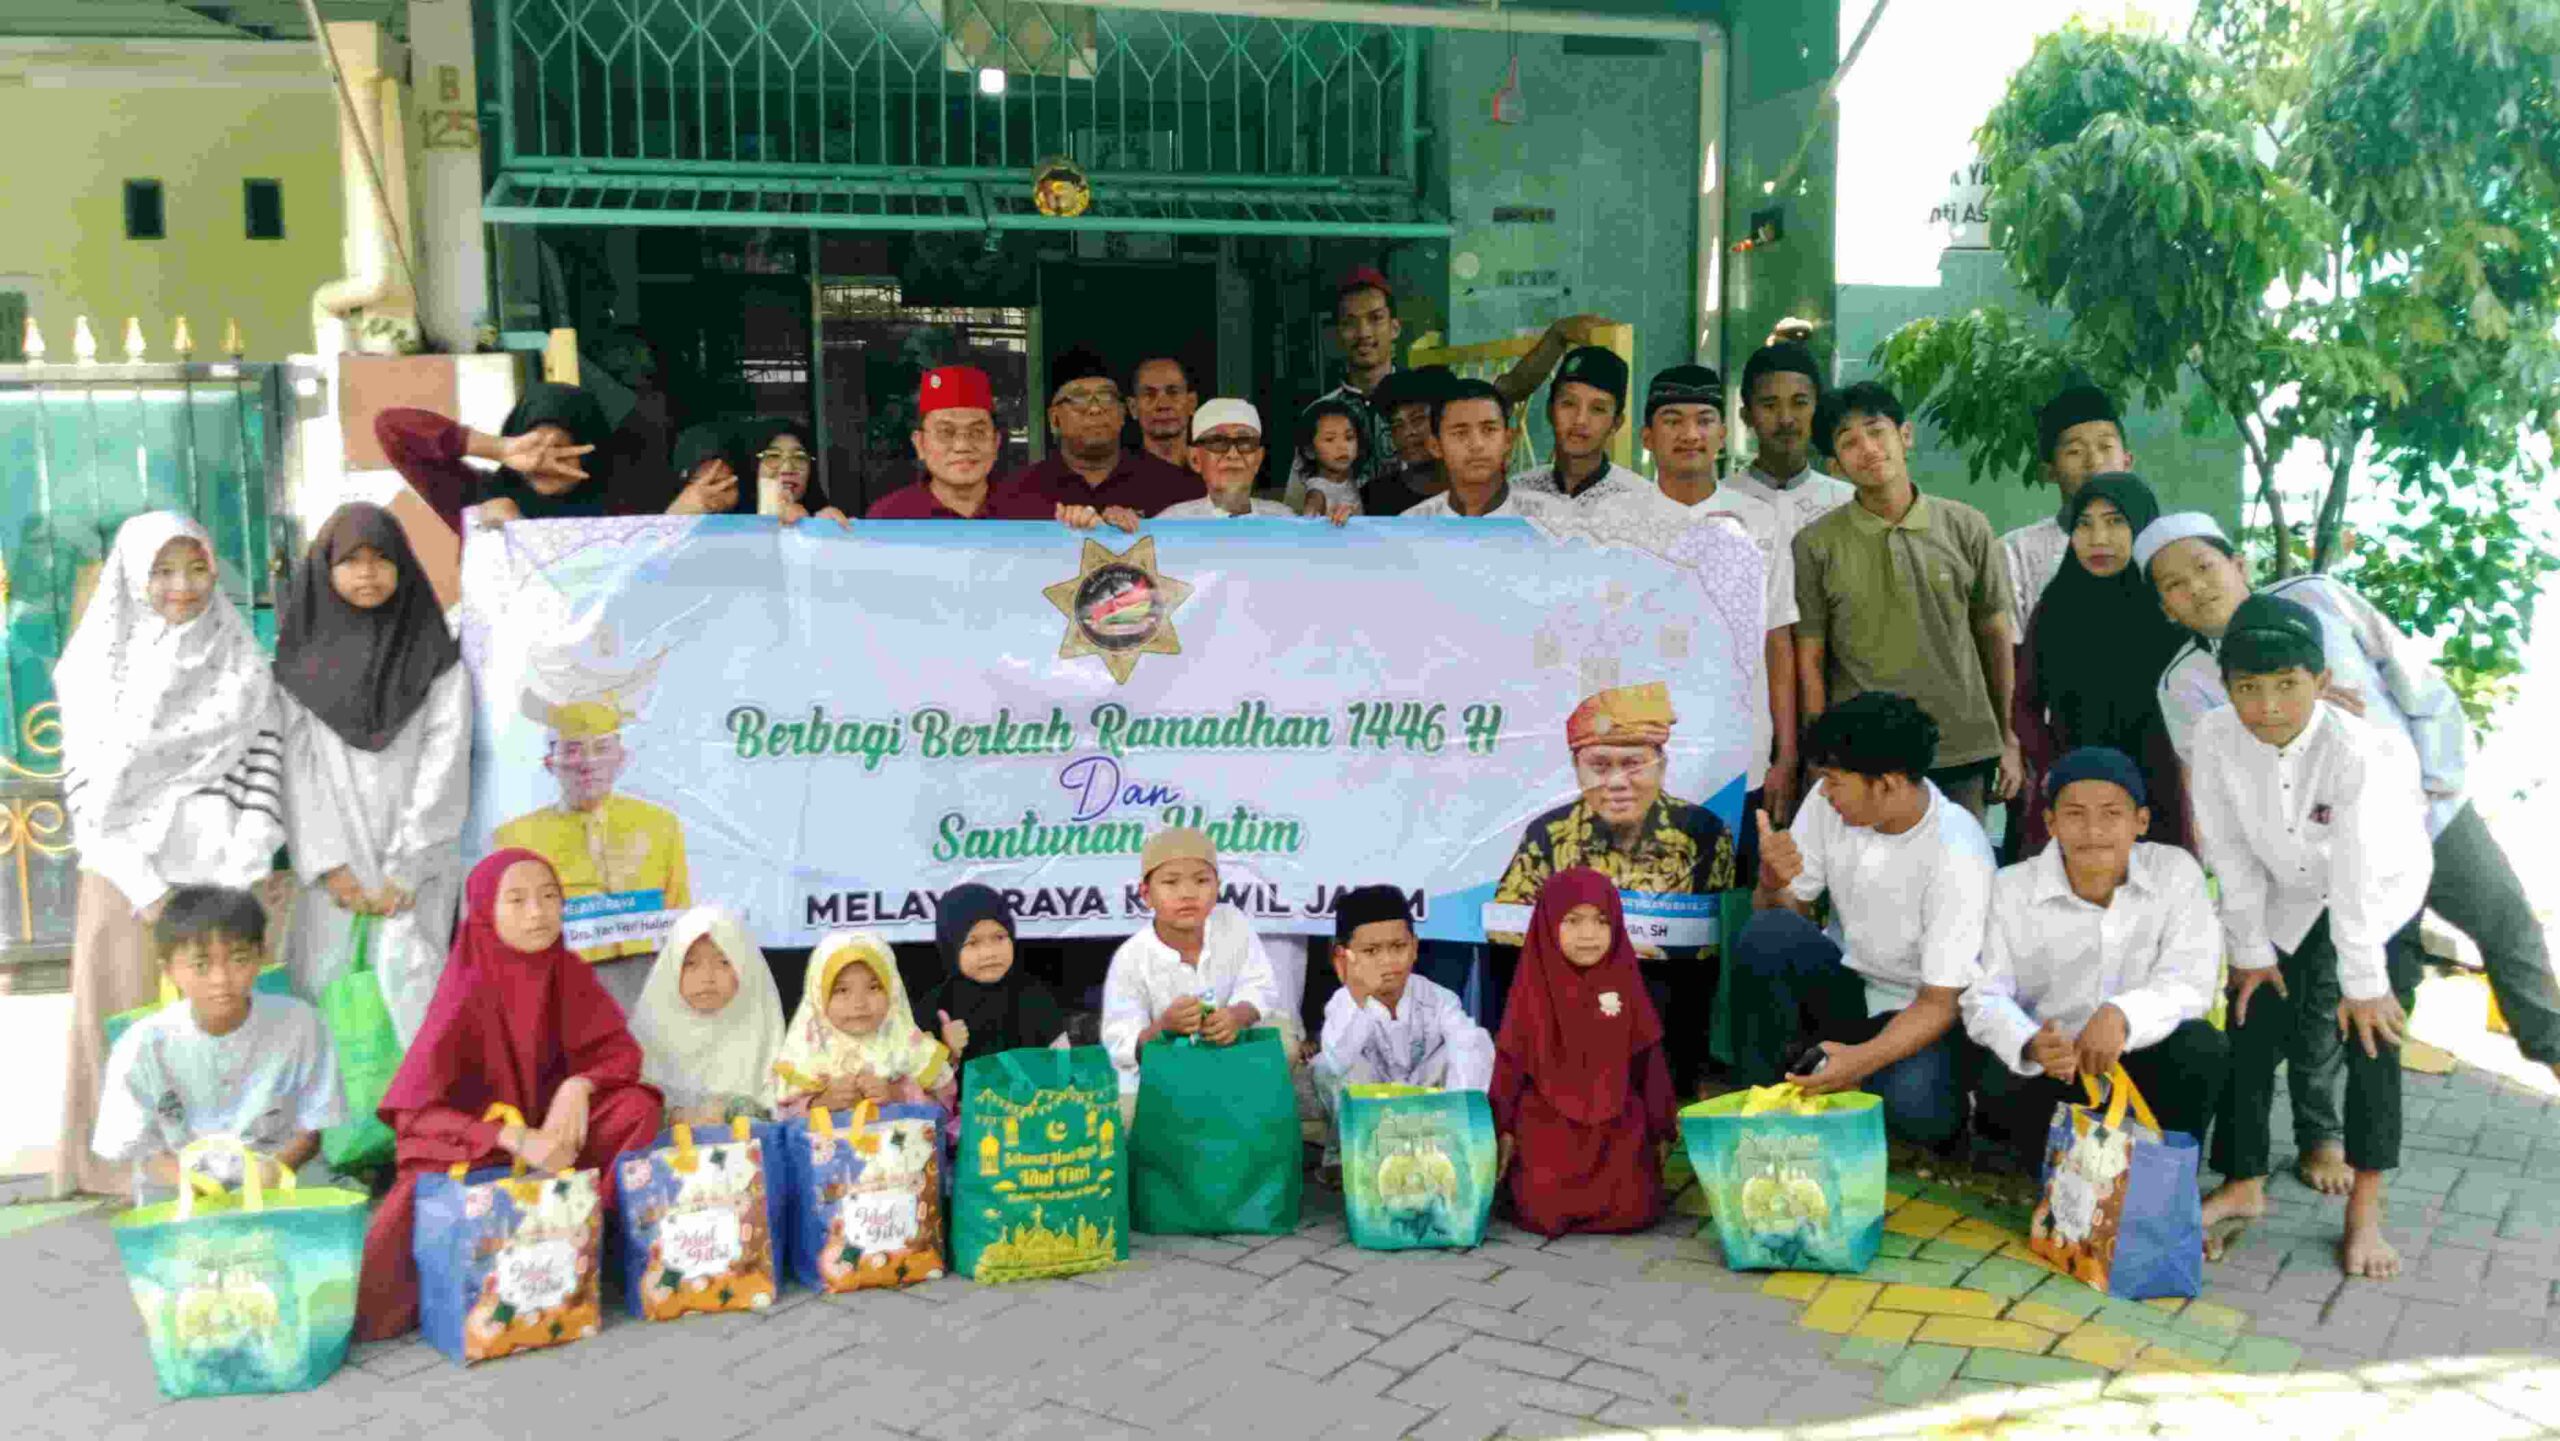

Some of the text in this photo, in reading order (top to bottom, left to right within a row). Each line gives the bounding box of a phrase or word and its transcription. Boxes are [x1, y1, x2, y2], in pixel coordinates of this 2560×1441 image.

[440, 65, 460, 103] B
[419, 109, 479, 148] 125
[726, 700, 1502, 771] Berbagi Berkah Ramadhan 1446 H
[1060, 756, 1181, 822] Dan
[932, 809, 1148, 861] Santunan
[1125, 882, 1291, 915] KWIL
[1650, 923, 1668, 938] SH
